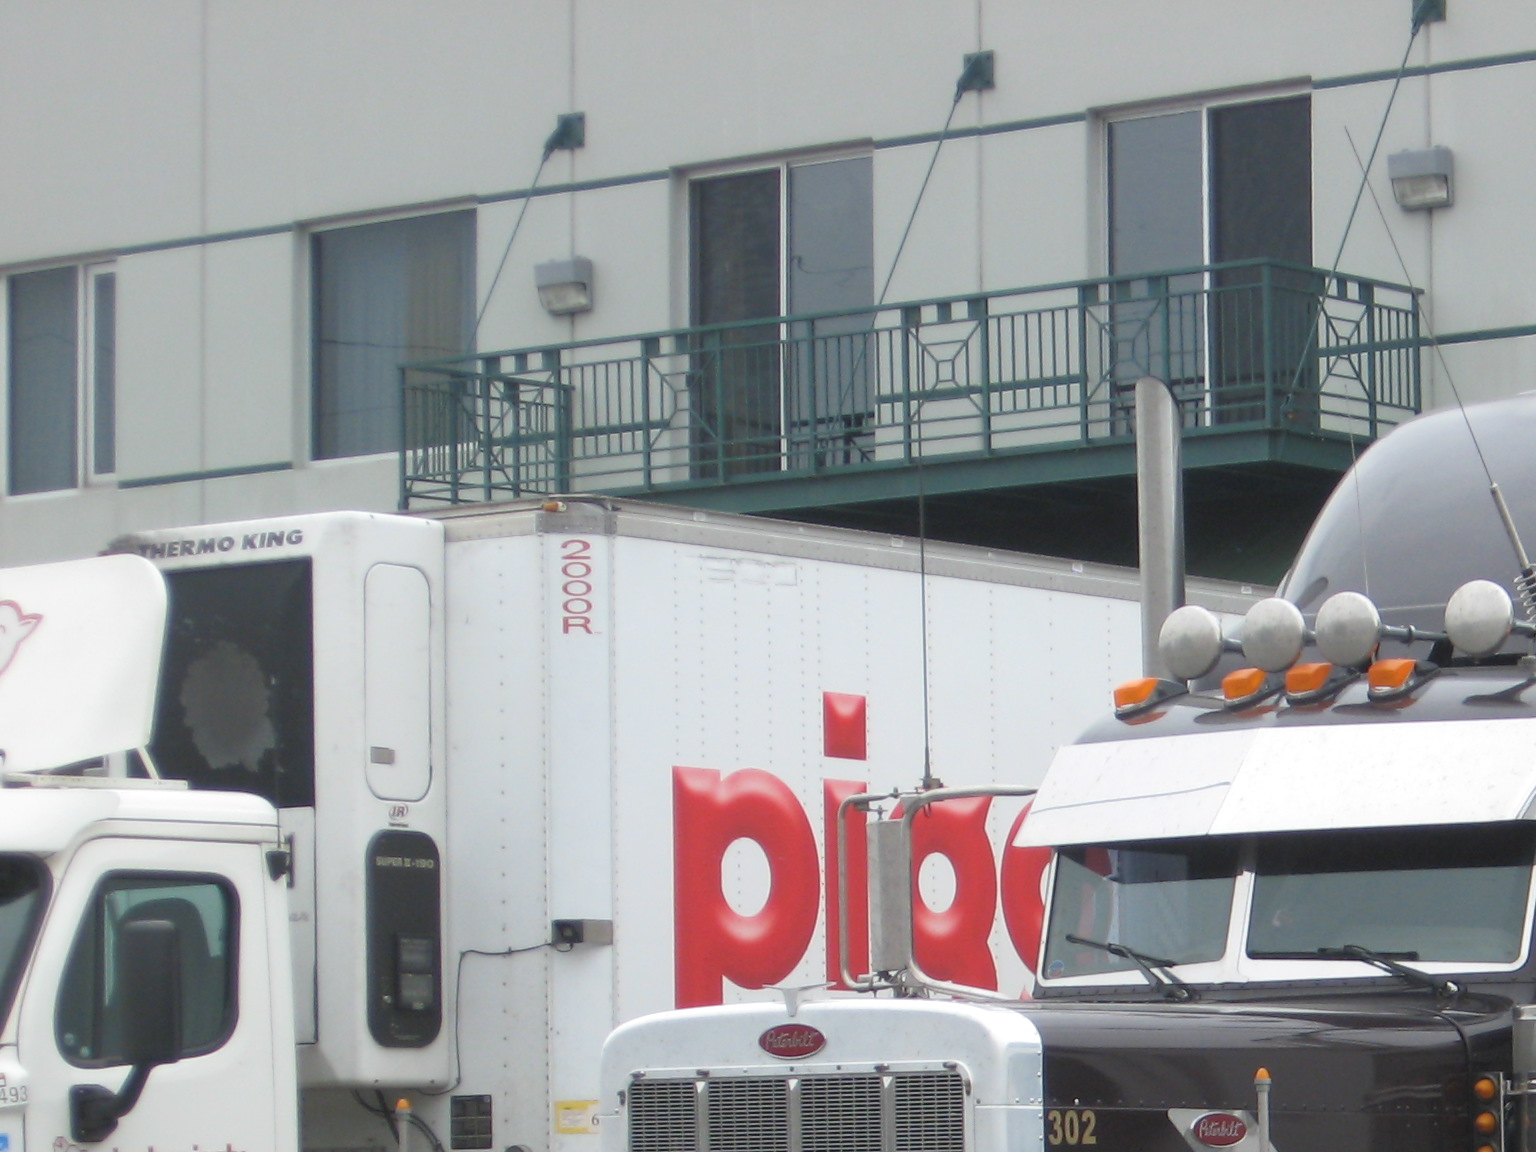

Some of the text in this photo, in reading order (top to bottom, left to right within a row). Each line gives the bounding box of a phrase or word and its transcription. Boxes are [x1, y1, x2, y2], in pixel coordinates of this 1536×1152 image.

[138, 529, 304, 559] THERMO KING
[561, 539, 593, 634] 2000R
[766, 1030, 819, 1050] Peterbilt
[1048, 1110, 1098, 1146] 302
[1199, 1119, 1243, 1138] Peterbilt
